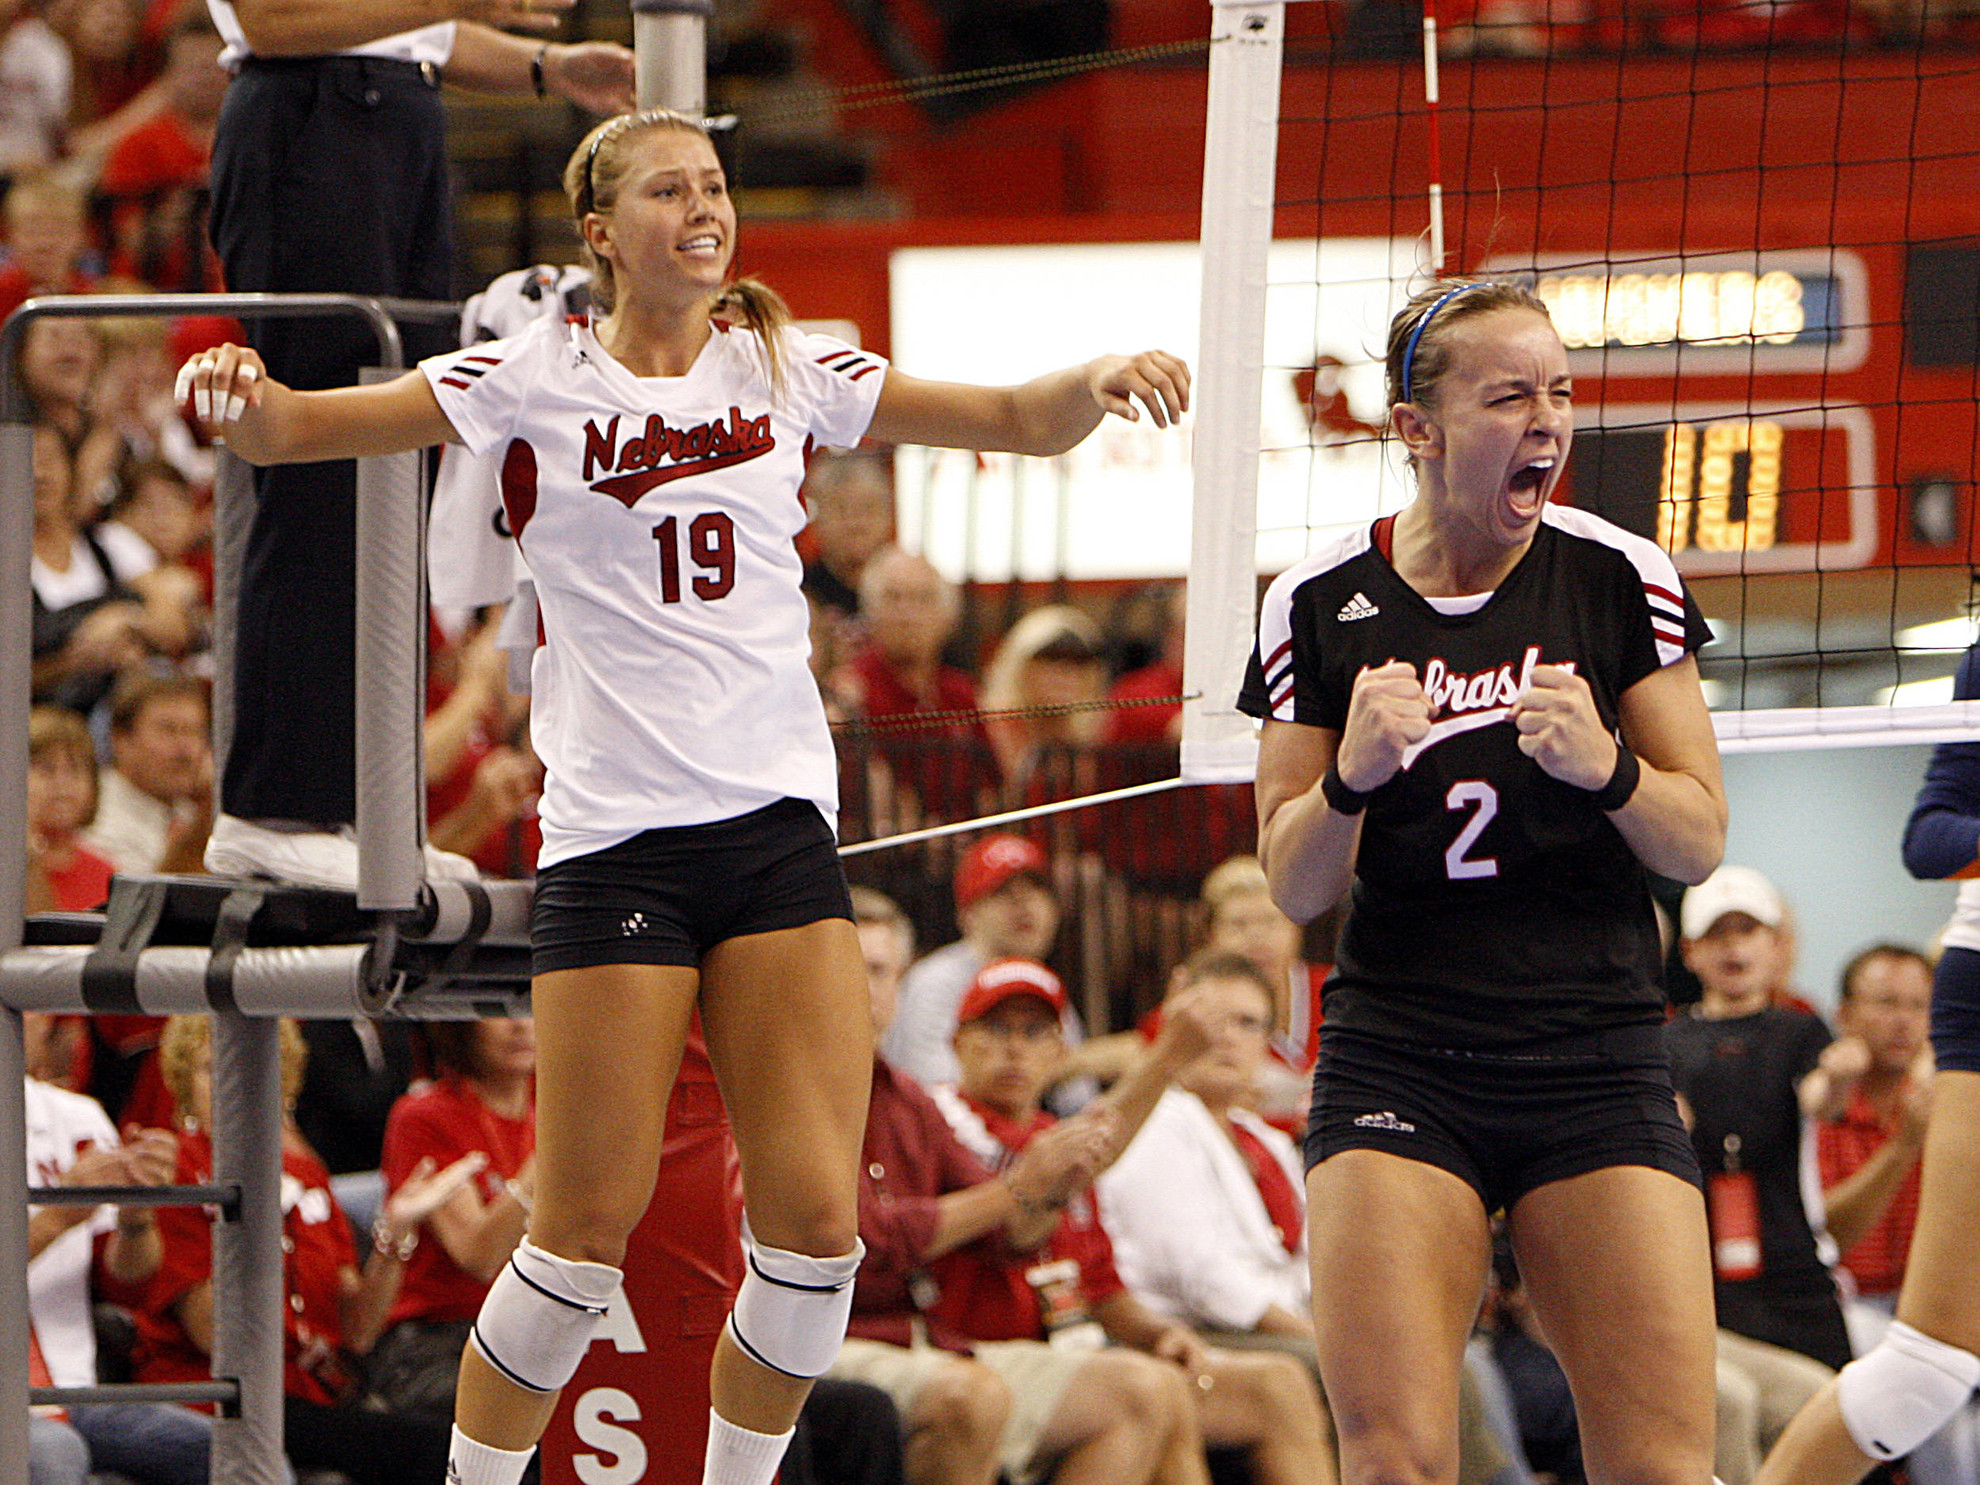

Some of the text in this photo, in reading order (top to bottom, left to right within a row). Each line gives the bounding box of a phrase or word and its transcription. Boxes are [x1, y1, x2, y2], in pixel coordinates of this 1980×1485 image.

[582, 405, 775, 482] Nebraska
[1656, 421, 1783, 553] 10
[652, 511, 735, 604] 19
[1337, 605, 1380, 622] adidas
[1444, 779, 1499, 880] 2
